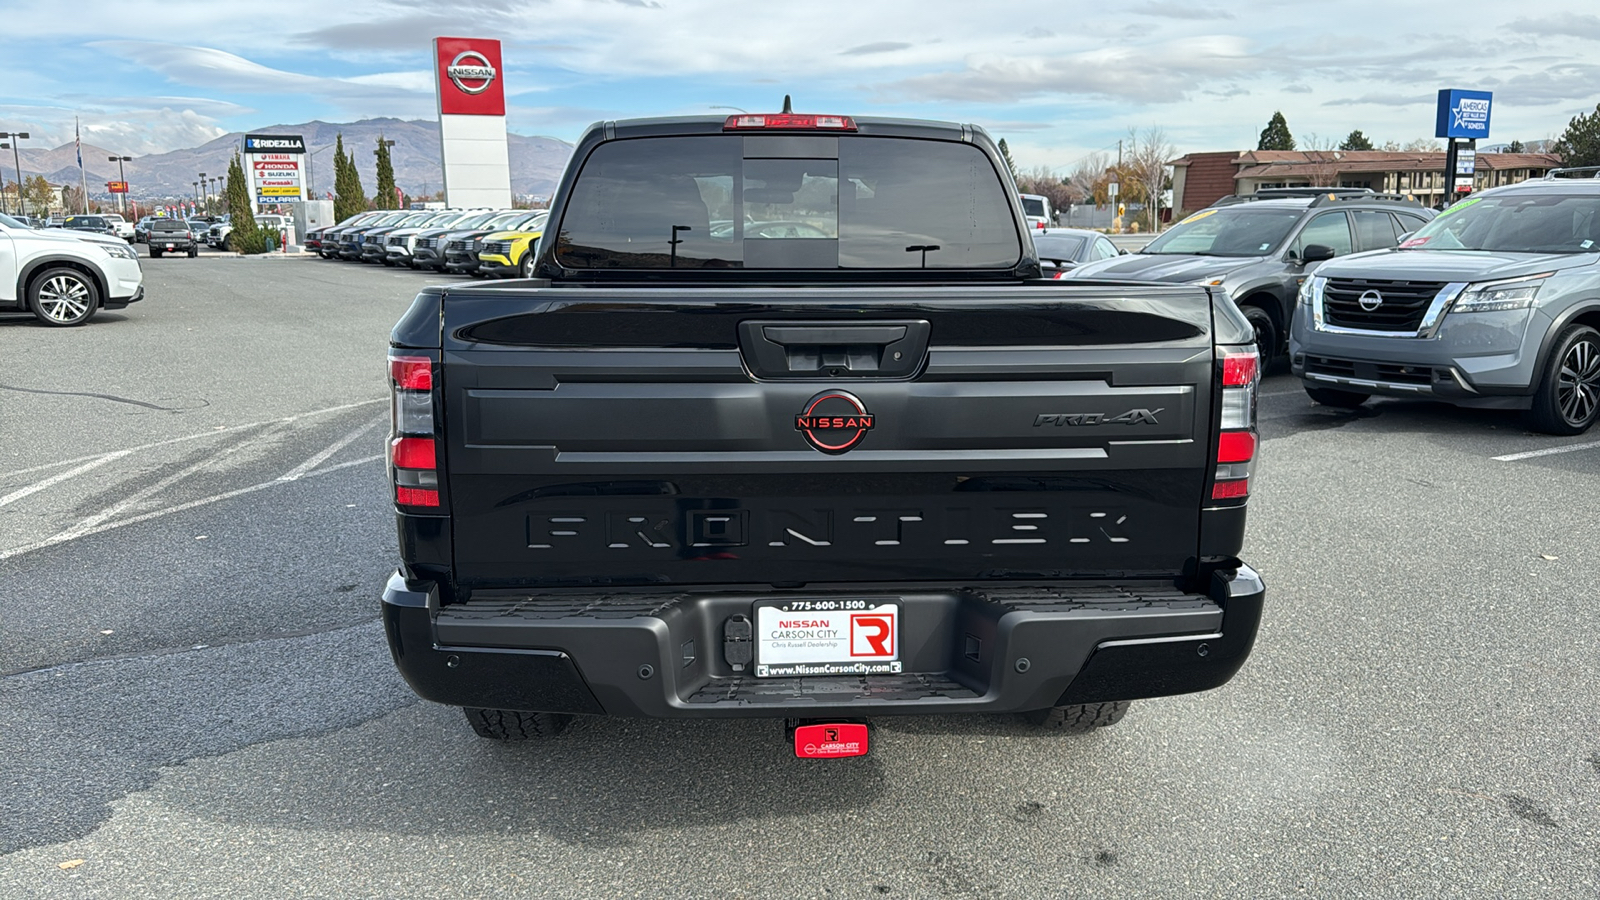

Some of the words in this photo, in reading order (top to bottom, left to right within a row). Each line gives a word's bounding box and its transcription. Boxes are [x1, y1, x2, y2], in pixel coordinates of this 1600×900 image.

[453, 68, 492, 76] NISSAN
[1463, 101, 1487, 111] AMERICAS
[260, 140, 302, 148] RIDEZILLA
[797, 417, 872, 428] NISSAN
[1033, 408, 1165, 427] PRO-4X
[526, 508, 1131, 547] FRONTIER
[791, 601, 866, 611] 775-600-1500
[778, 620, 830, 628] NISSAN
[771, 630, 814, 639] CARSON
[817, 629, 838, 638] CITY
[807, 640, 838, 649] Dealership
[769, 663, 890, 675] www.NissanCarsonCity.com
